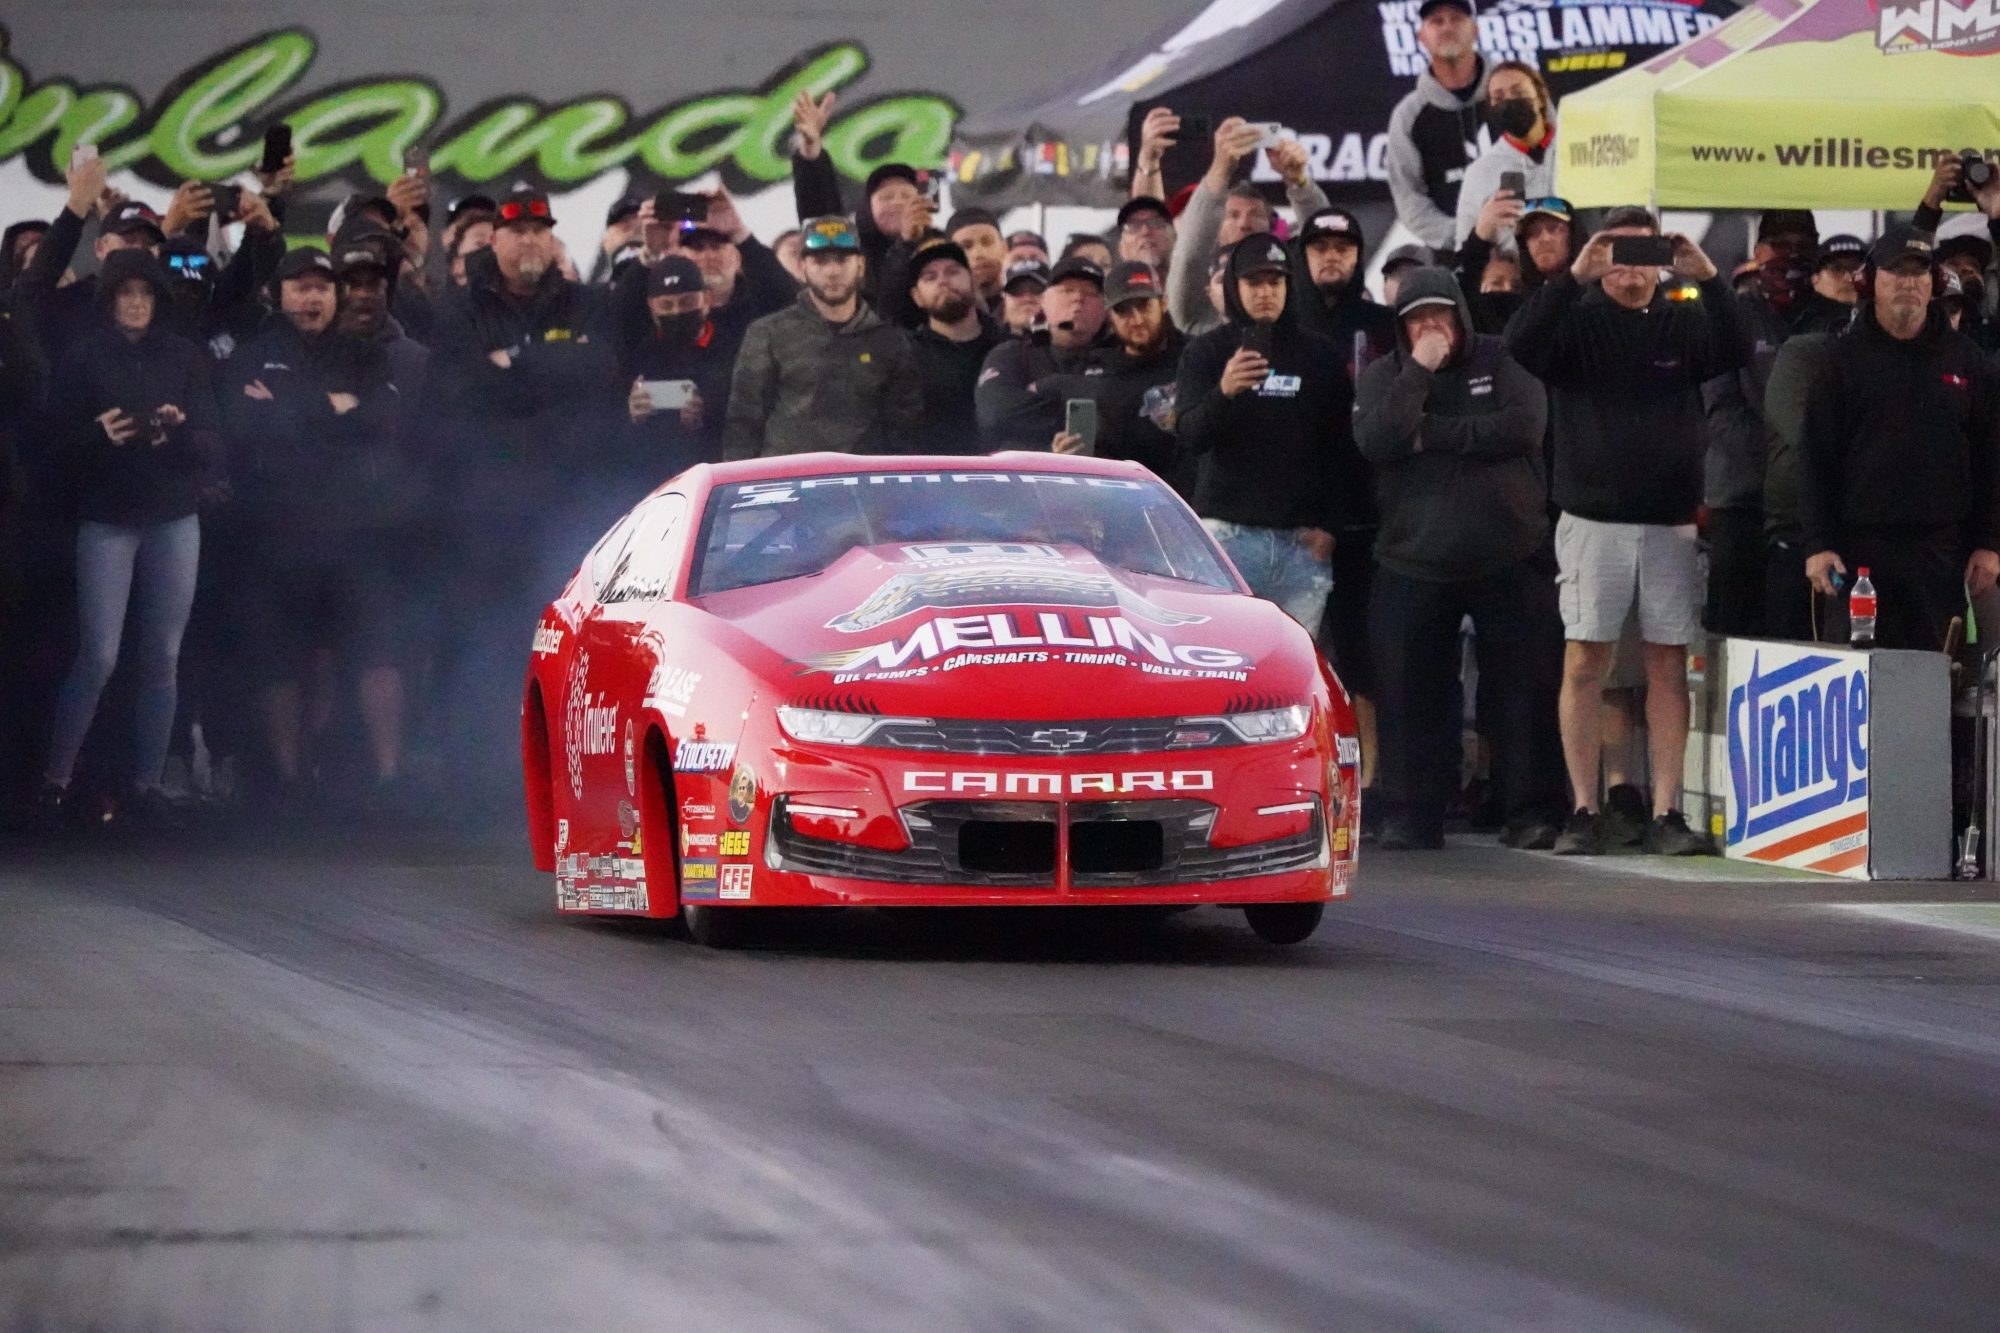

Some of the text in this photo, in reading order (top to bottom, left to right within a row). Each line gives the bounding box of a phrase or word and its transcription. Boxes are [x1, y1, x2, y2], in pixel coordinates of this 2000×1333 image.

[838, 613, 1244, 671] MELLING
[833, 651, 1248, 685] OIL PUMPS CAMSHAFTS TIMING VALVE TRAIN
[1728, 648, 1868, 847] Strange
[903, 770, 1214, 794] CAMARO
[720, 831, 751, 856] JEGS
[722, 867, 750, 891] CFE
